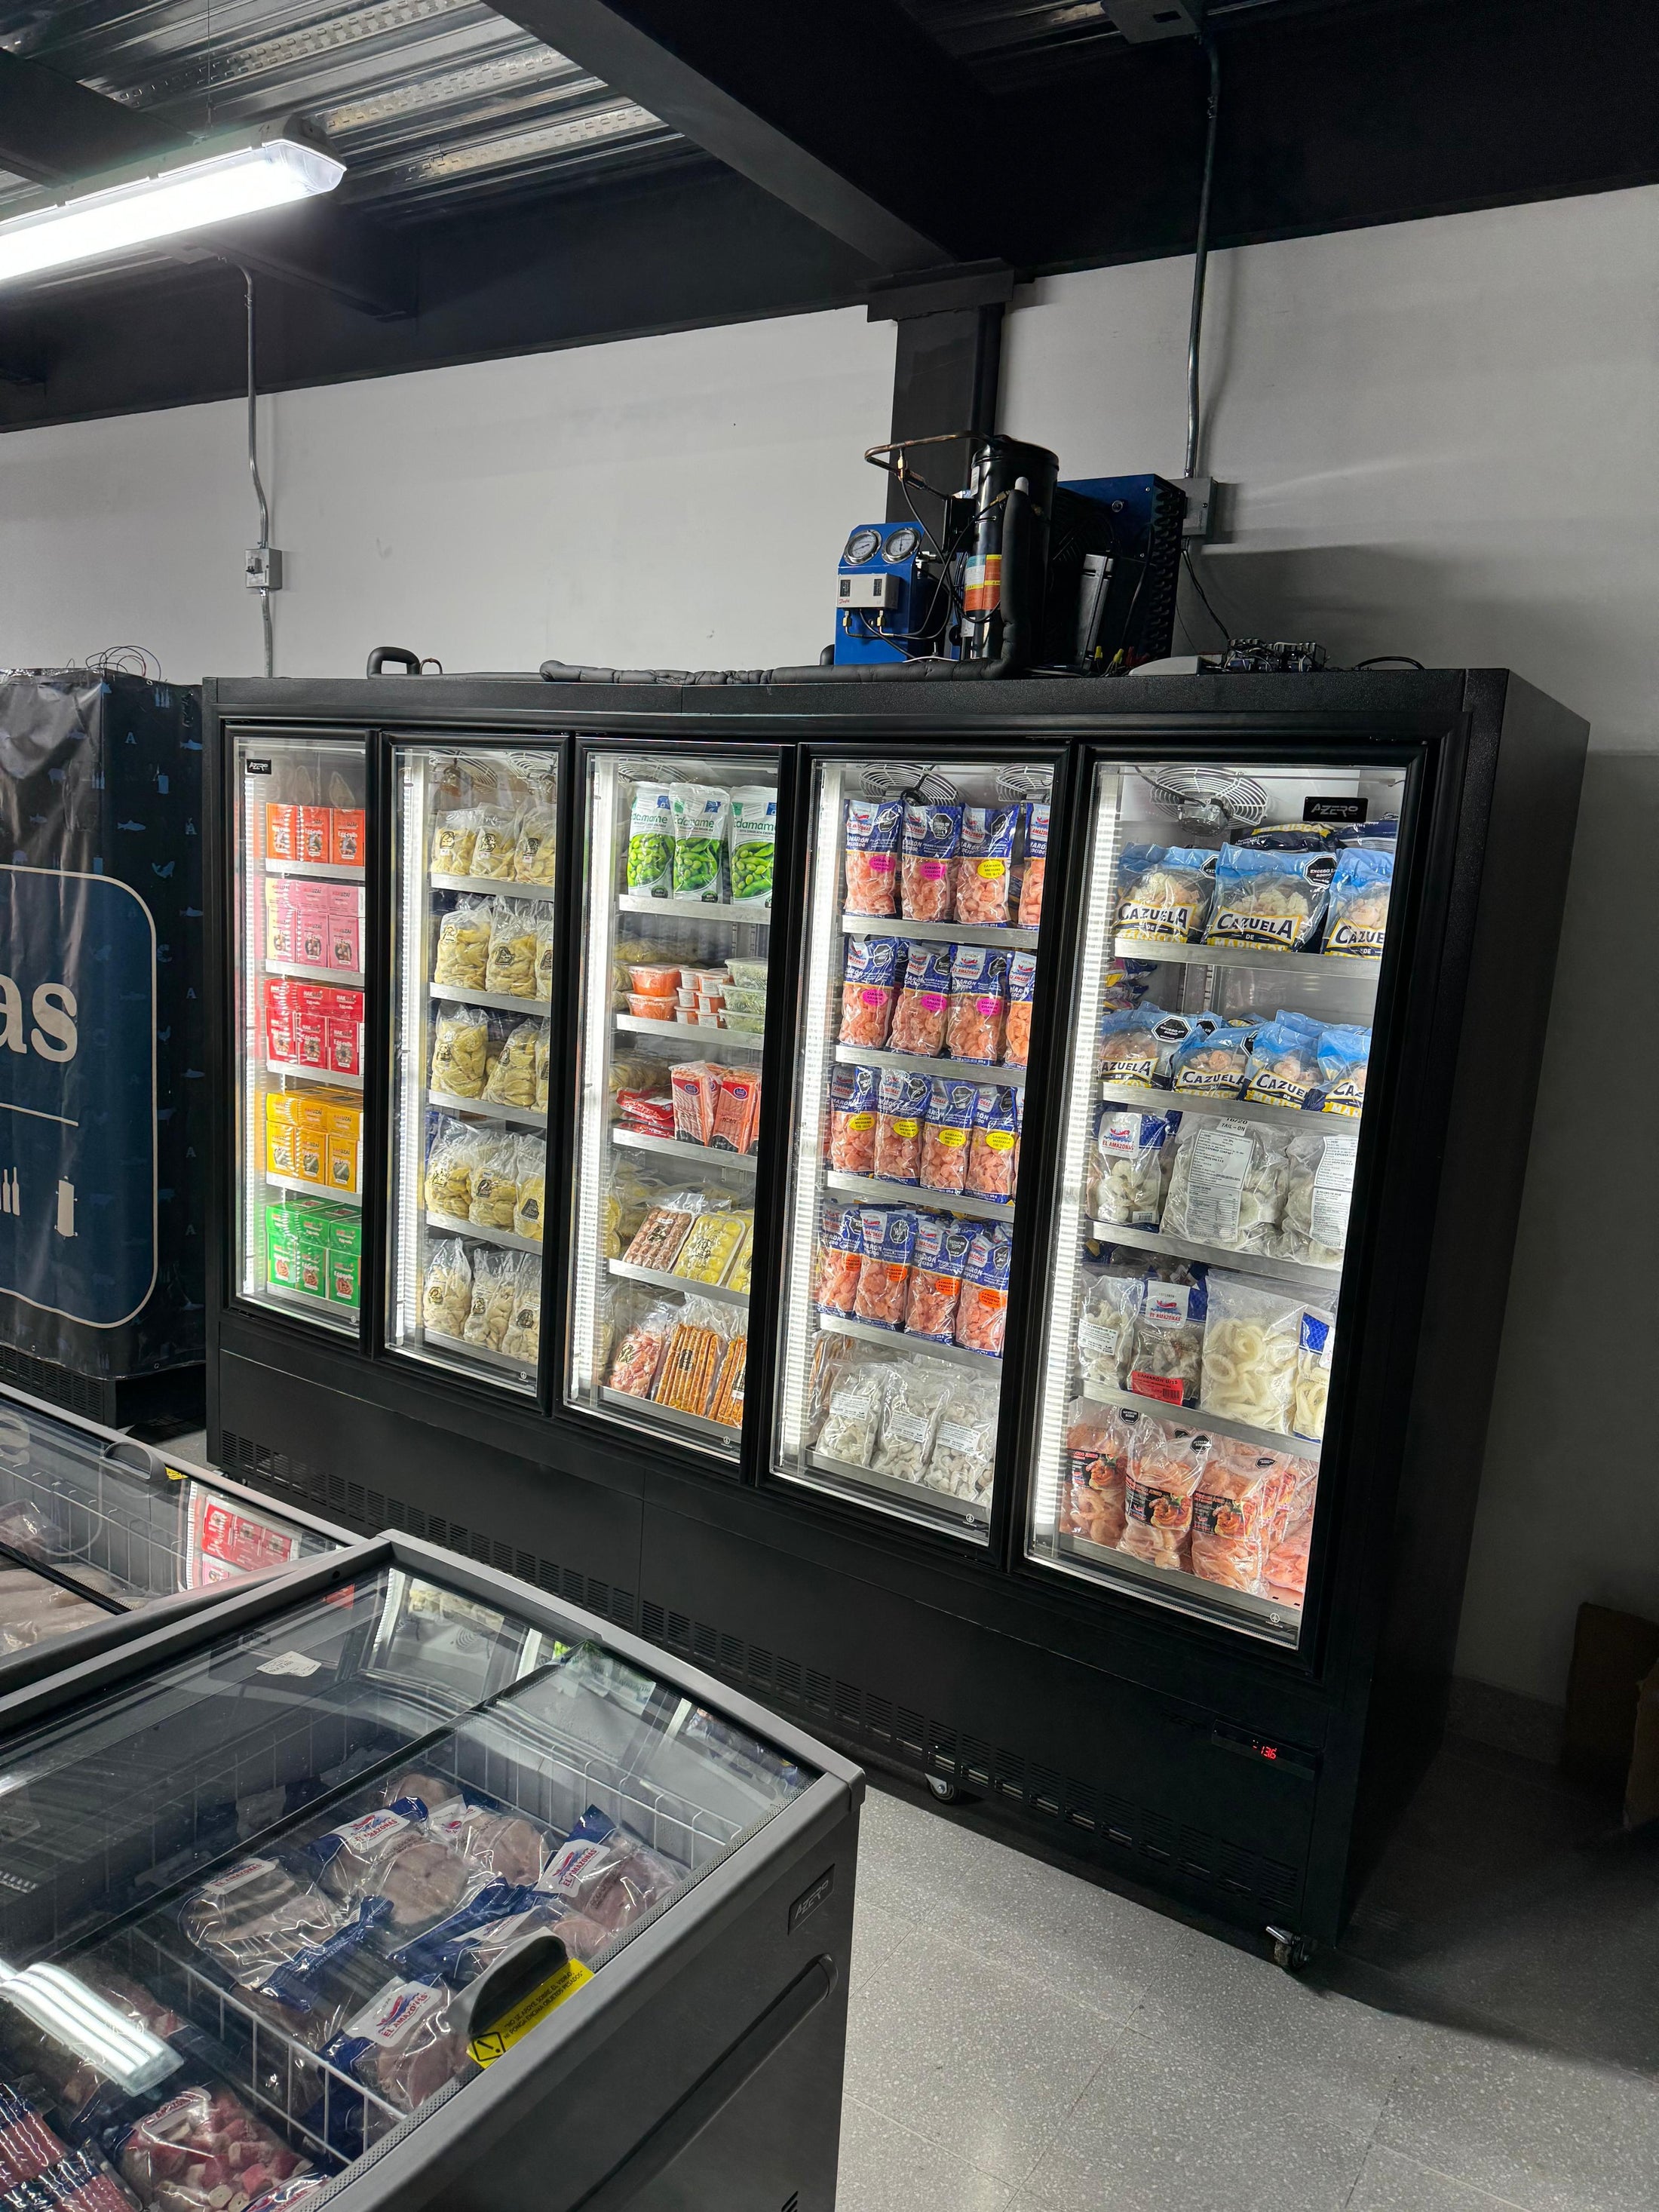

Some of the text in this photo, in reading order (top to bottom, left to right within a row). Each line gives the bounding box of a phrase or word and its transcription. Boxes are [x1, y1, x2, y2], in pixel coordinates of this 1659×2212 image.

[1311, 803, 1359, 818] AZERO
[1118, 903, 1188, 930] CAZUELA
[1217, 913, 1293, 940] CAZUELA
[1335, 925, 1385, 944] CAZUE
[1102, 1061, 1151, 1076] AZUELA
[1256, 1074, 1305, 1097] CAZUE
[1109, 1140, 1134, 1151] AMAZONAS
[564, 1847, 597, 1888] EL AMAZONAS
[381, 1992, 428, 2037] EL AMAZONAS
